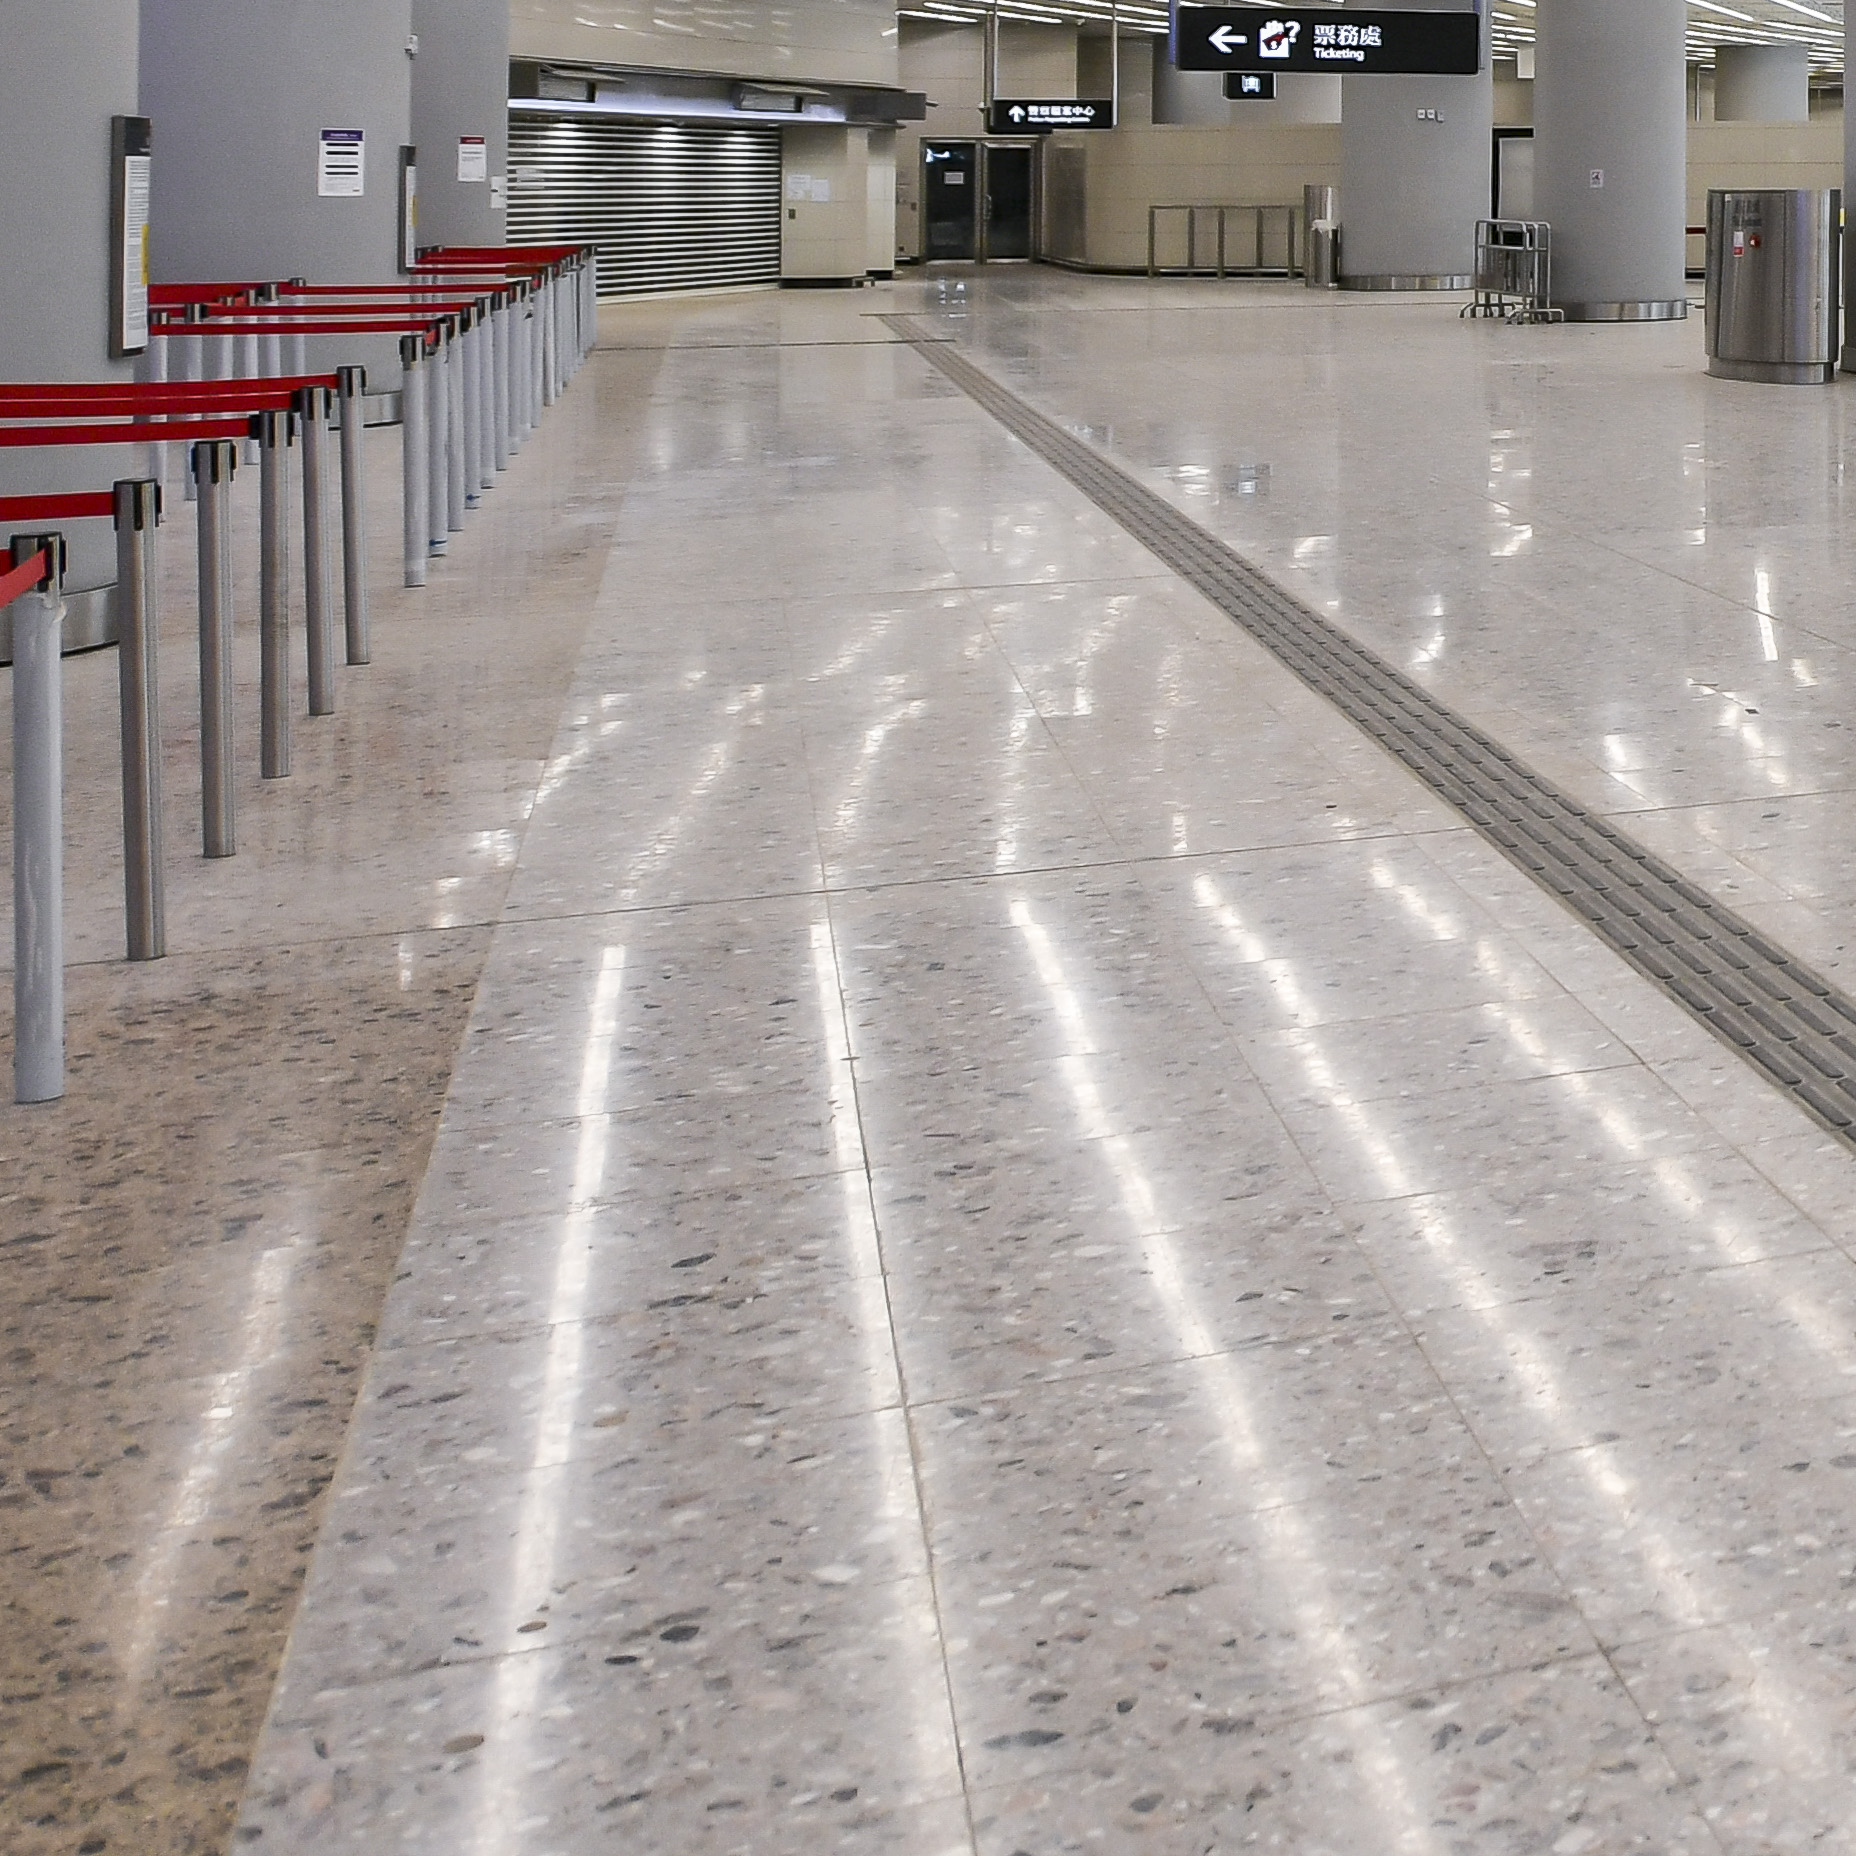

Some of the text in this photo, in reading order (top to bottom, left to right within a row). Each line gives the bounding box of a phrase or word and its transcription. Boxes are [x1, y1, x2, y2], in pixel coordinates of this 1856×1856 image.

[1313, 24, 1382, 46] 票務處
[1312, 47, 1365, 62] Ticketing
